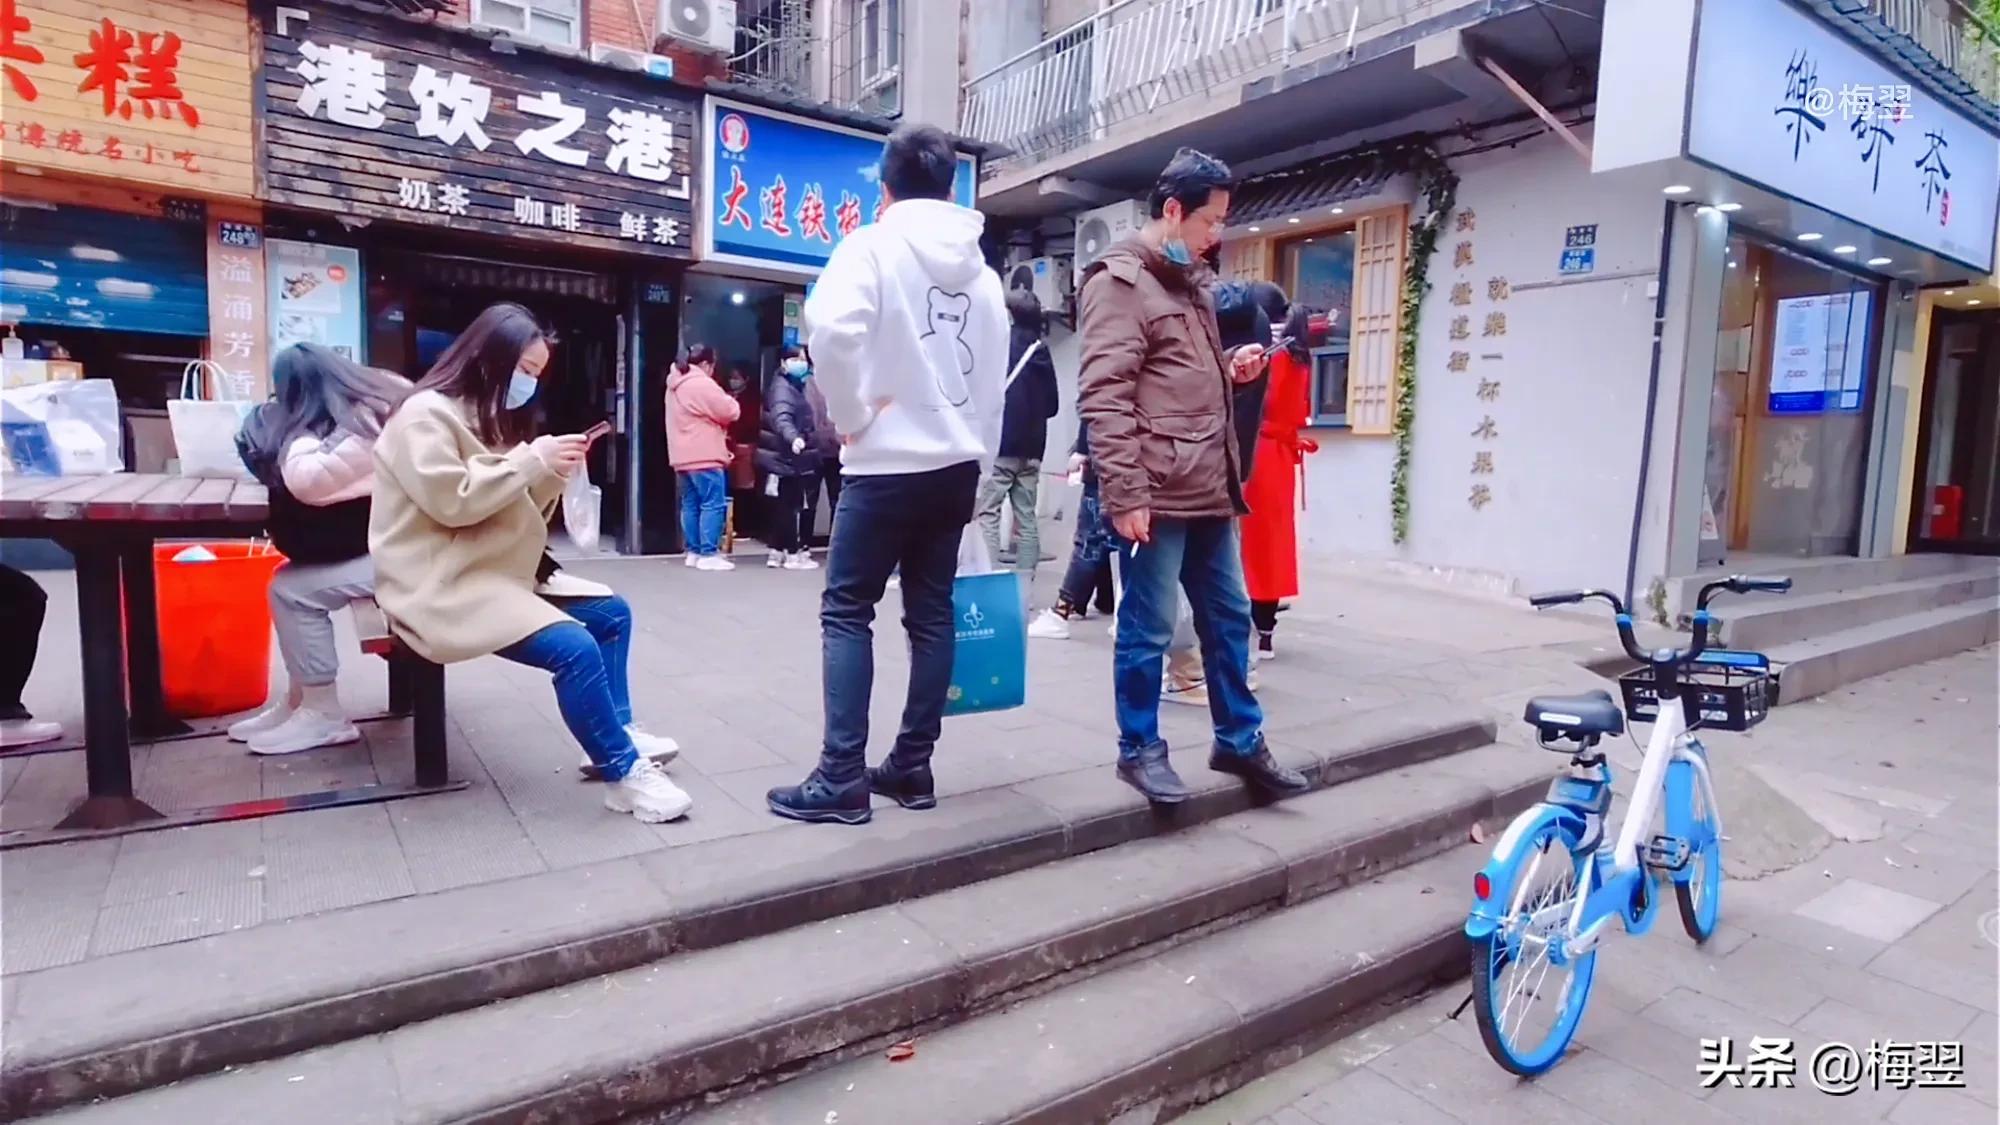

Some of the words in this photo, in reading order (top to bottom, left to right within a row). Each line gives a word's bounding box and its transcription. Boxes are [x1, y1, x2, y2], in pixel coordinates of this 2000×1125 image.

[286, 40, 677, 183] 港饮之港
[398, 177, 472, 217] 奶茶
[513, 195, 582, 232] 咖啡
[619, 211, 680, 246] 鲜茶
